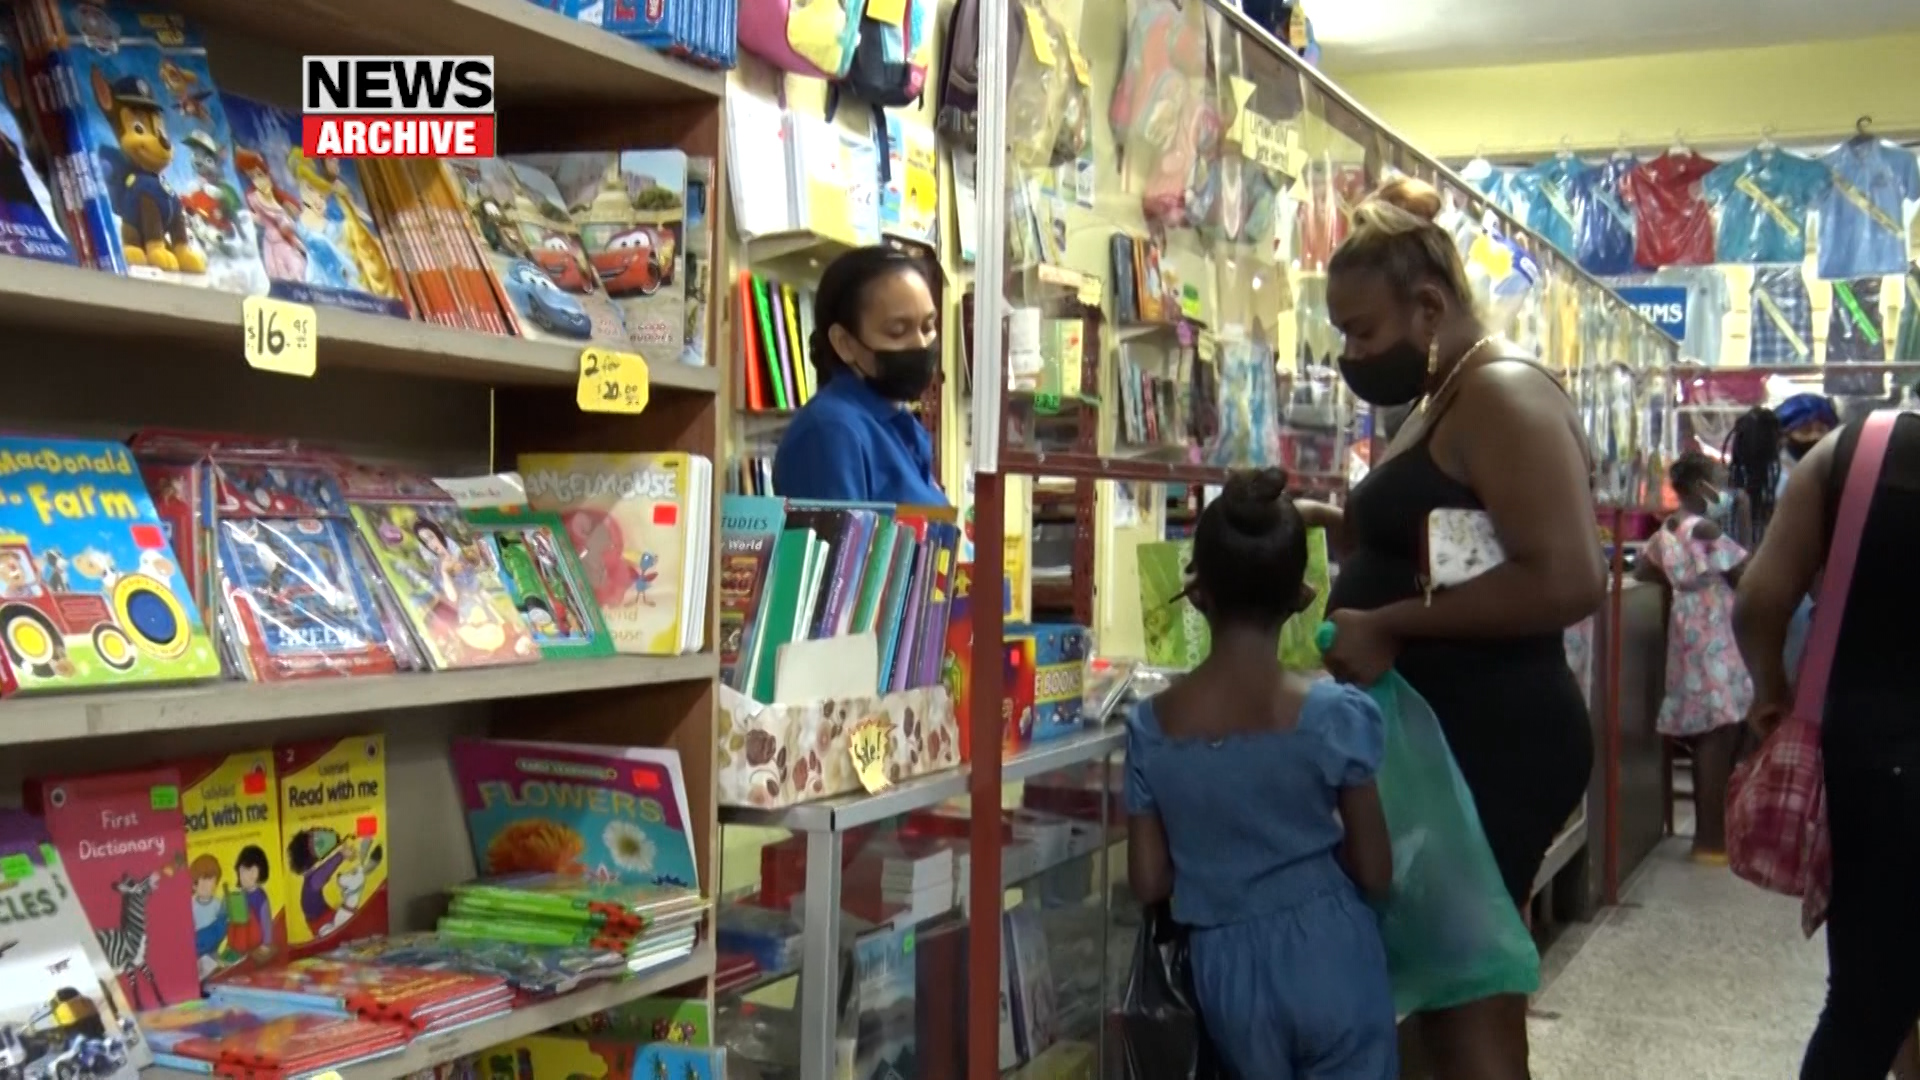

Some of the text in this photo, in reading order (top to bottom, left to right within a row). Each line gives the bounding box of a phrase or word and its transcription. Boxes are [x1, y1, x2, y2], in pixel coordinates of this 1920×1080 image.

[1629, 303, 1683, 323] RMS
[526, 470, 678, 501] ANGELMOUSE
[27, 483, 140, 525] Farm
[720, 516, 769, 531] TUDIES
[728, 538, 764, 551] World
[288, 778, 379, 808] Read with me
[476, 779, 670, 823] FLOWERS
[101, 809, 139, 830] First
[184, 805, 209, 833] ead
[211, 802, 243, 828] with
[246, 803, 269, 822] me
[79, 836, 165, 861] Dictionary
